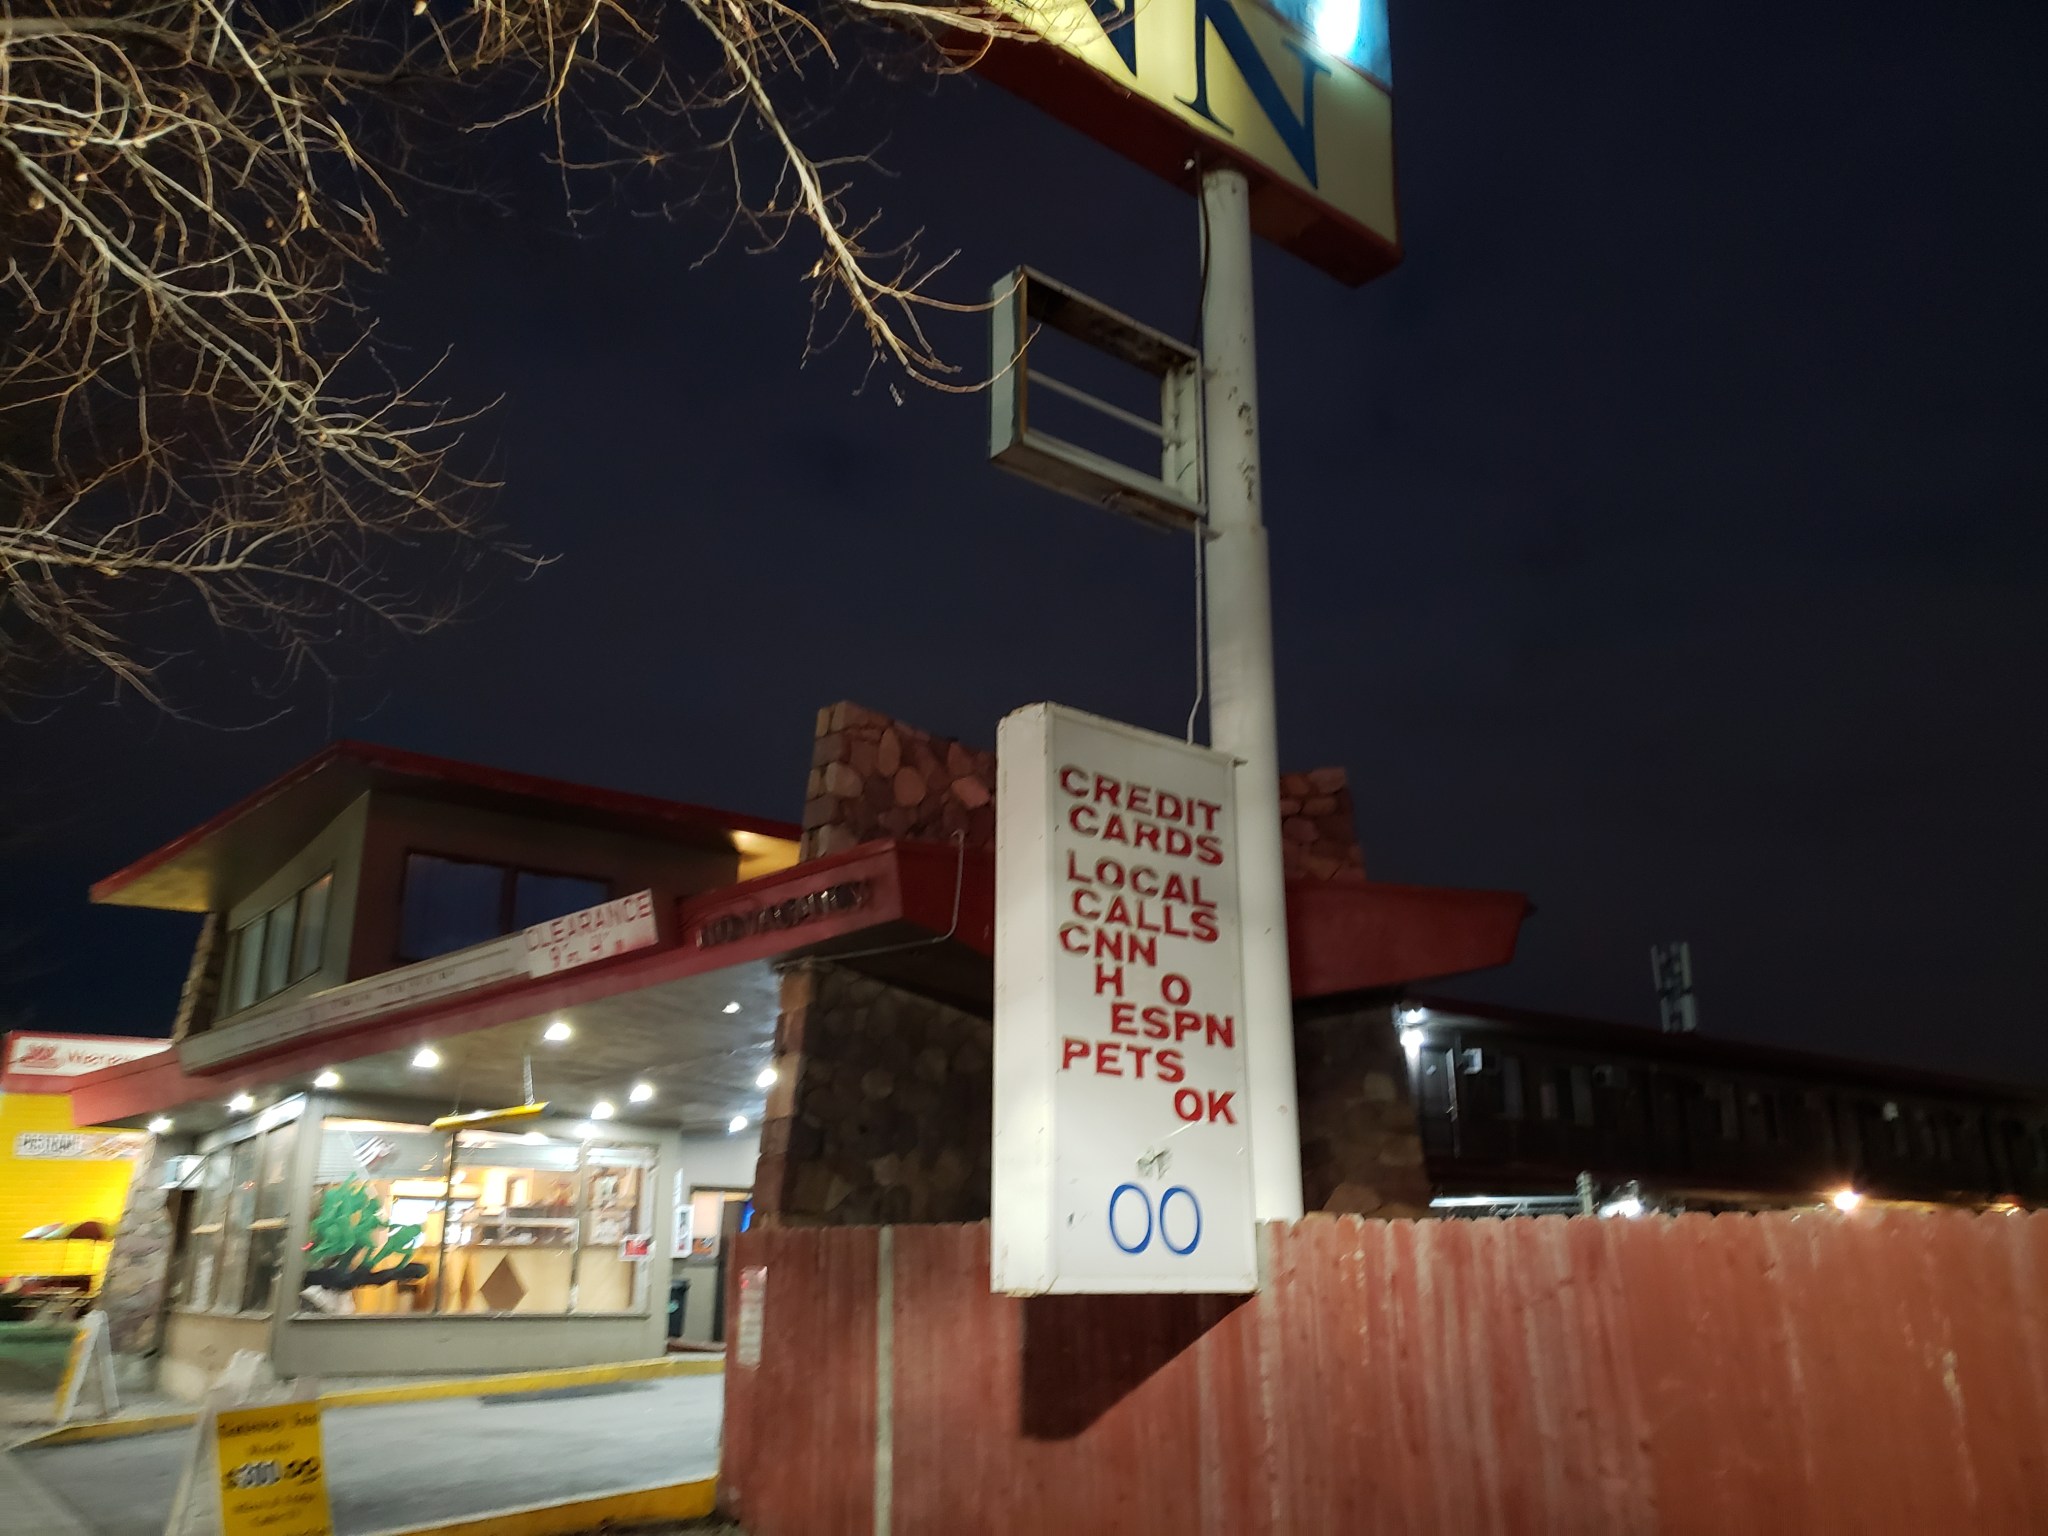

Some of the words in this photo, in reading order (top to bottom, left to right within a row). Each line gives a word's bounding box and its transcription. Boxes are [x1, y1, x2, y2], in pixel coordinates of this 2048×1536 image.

[1058, 764, 1223, 832] CREDIT
[1068, 803, 1224, 867] CARDS
[1067, 848, 1218, 910] LOCAL
[524, 891, 652, 952] CLEARANCE
[1071, 887, 1220, 943] CALLS
[1058, 920, 1158, 967] CNN
[1110, 1002, 1236, 1049] ESPN
[1061, 1037, 1186, 1085] PETS
[1173, 1086, 1237, 1125] OK
